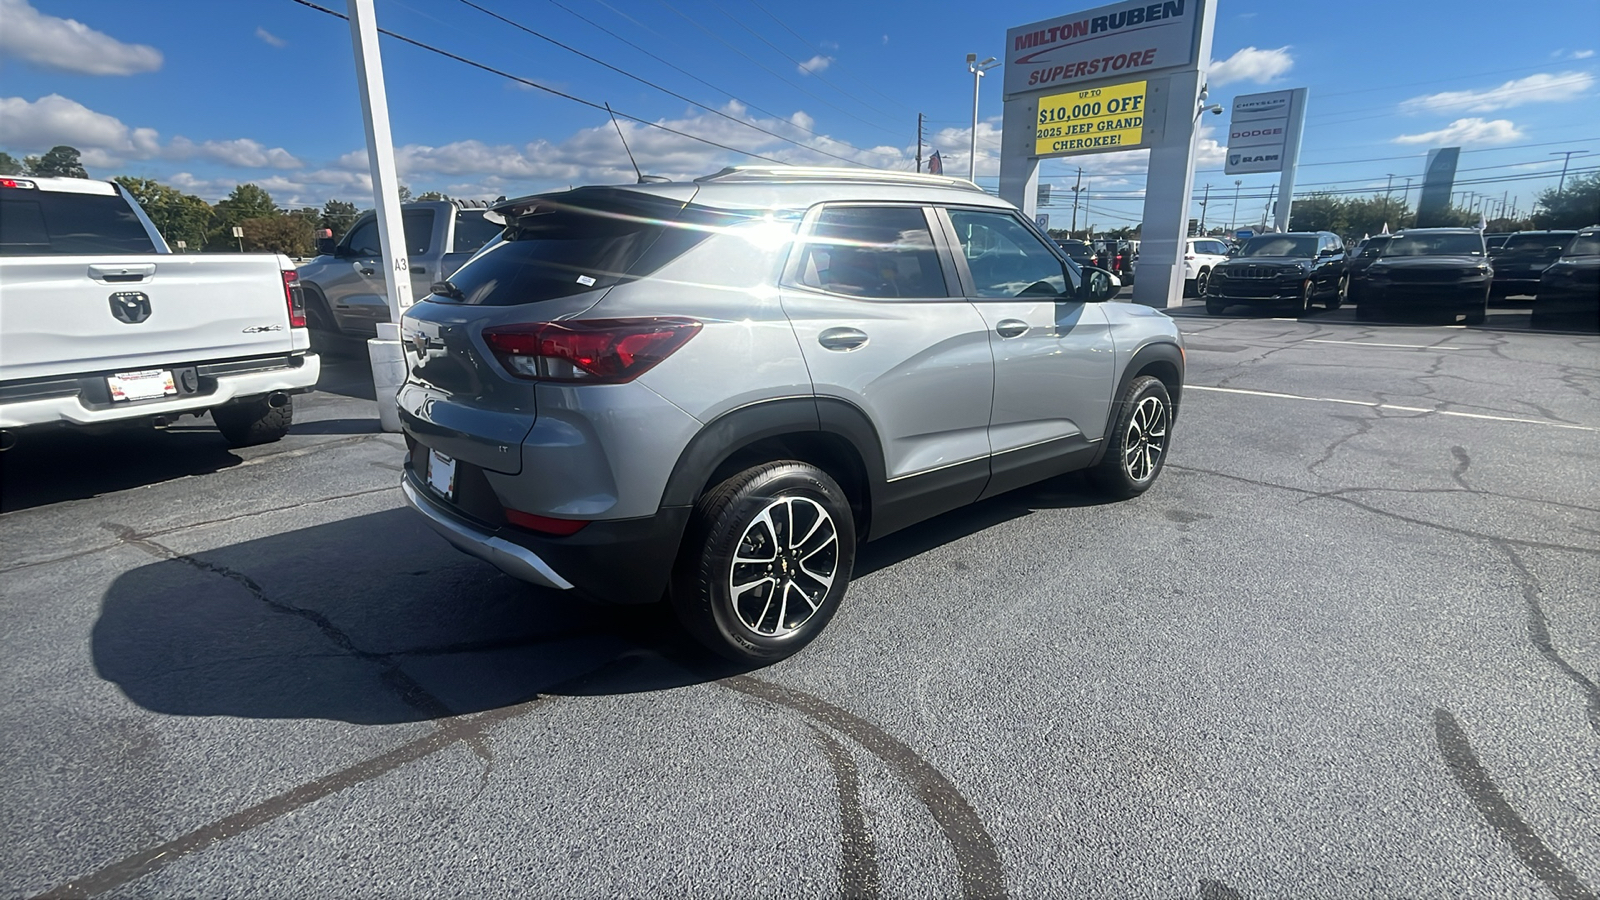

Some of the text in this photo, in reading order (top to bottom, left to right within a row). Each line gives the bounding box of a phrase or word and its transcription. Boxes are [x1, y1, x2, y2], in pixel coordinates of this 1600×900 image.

[1015, 0, 1185, 51] MILTON RUBEN
[1028, 48, 1157, 86] SUPERSTORE
[1039, 95, 1143, 124] $10,000 OFF
[1236, 99, 1285, 109] CHRYSLER
[1037, 116, 1142, 138] 2025 JEEP GRAND
[1231, 127, 1283, 139] DODGE
[1052, 134, 1121, 151] CHEROKEE!
[1242, 154, 1279, 163] RAM
[395, 258, 407, 271] A3
